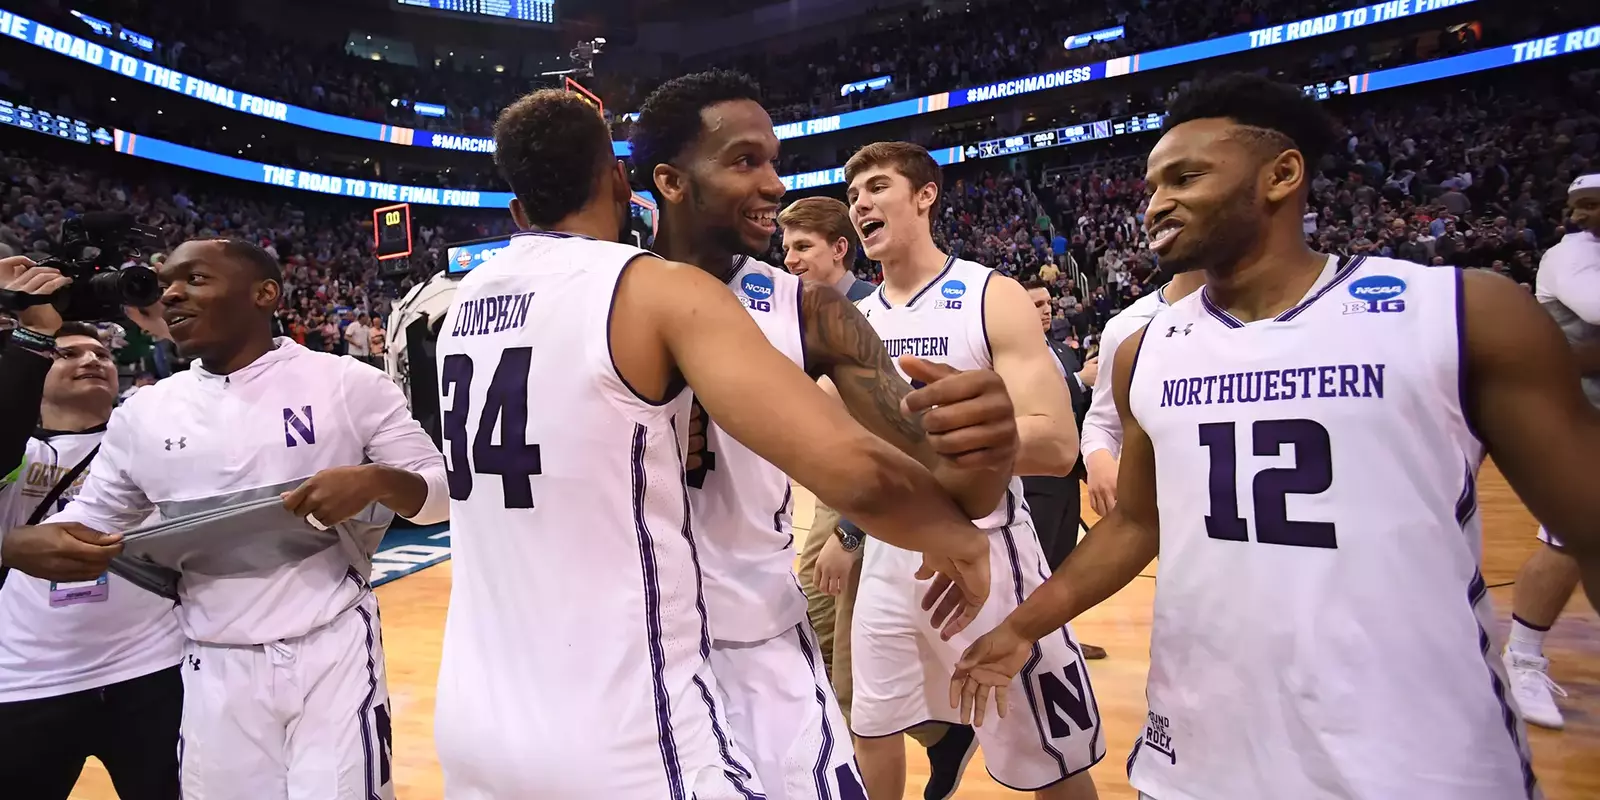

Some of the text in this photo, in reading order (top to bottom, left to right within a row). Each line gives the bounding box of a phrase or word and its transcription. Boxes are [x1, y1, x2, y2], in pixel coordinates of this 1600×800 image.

[1249, 26, 1283, 48] THE
[1287, 15, 1337, 41] ROAD
[1342, 7, 1367, 28] TO
[1372, 0, 1409, 22] THE
[1511, 25, 1600, 63] THE RO
[0, 10, 30, 40] HE
[35, 24, 104, 65] ROAD
[110, 50, 138, 77] TO
[143, 62, 182, 92] THE
[185, 76, 237, 109] FINAL
[240, 94, 288, 121] FOUR
[966, 66, 1092, 102] #MARCHMADNESS
[431, 133, 498, 153] #MARCHM
[807, 115, 841, 135] FOUR
[263, 165, 481, 207] THE ROAD TO THE FINAL FOUR
[796, 169, 832, 189] FINAL
[745, 282, 772, 295] NCAA
[1354, 285, 1402, 295] NCAA
[451, 291, 535, 337] LUMPKIN
[1160, 364, 1385, 407] NORTHWESTERN
[441, 346, 543, 509] 34
[1198, 418, 1338, 549] 12
[1038, 660, 1093, 739] N
[1145, 726, 1172, 751] ROCK
